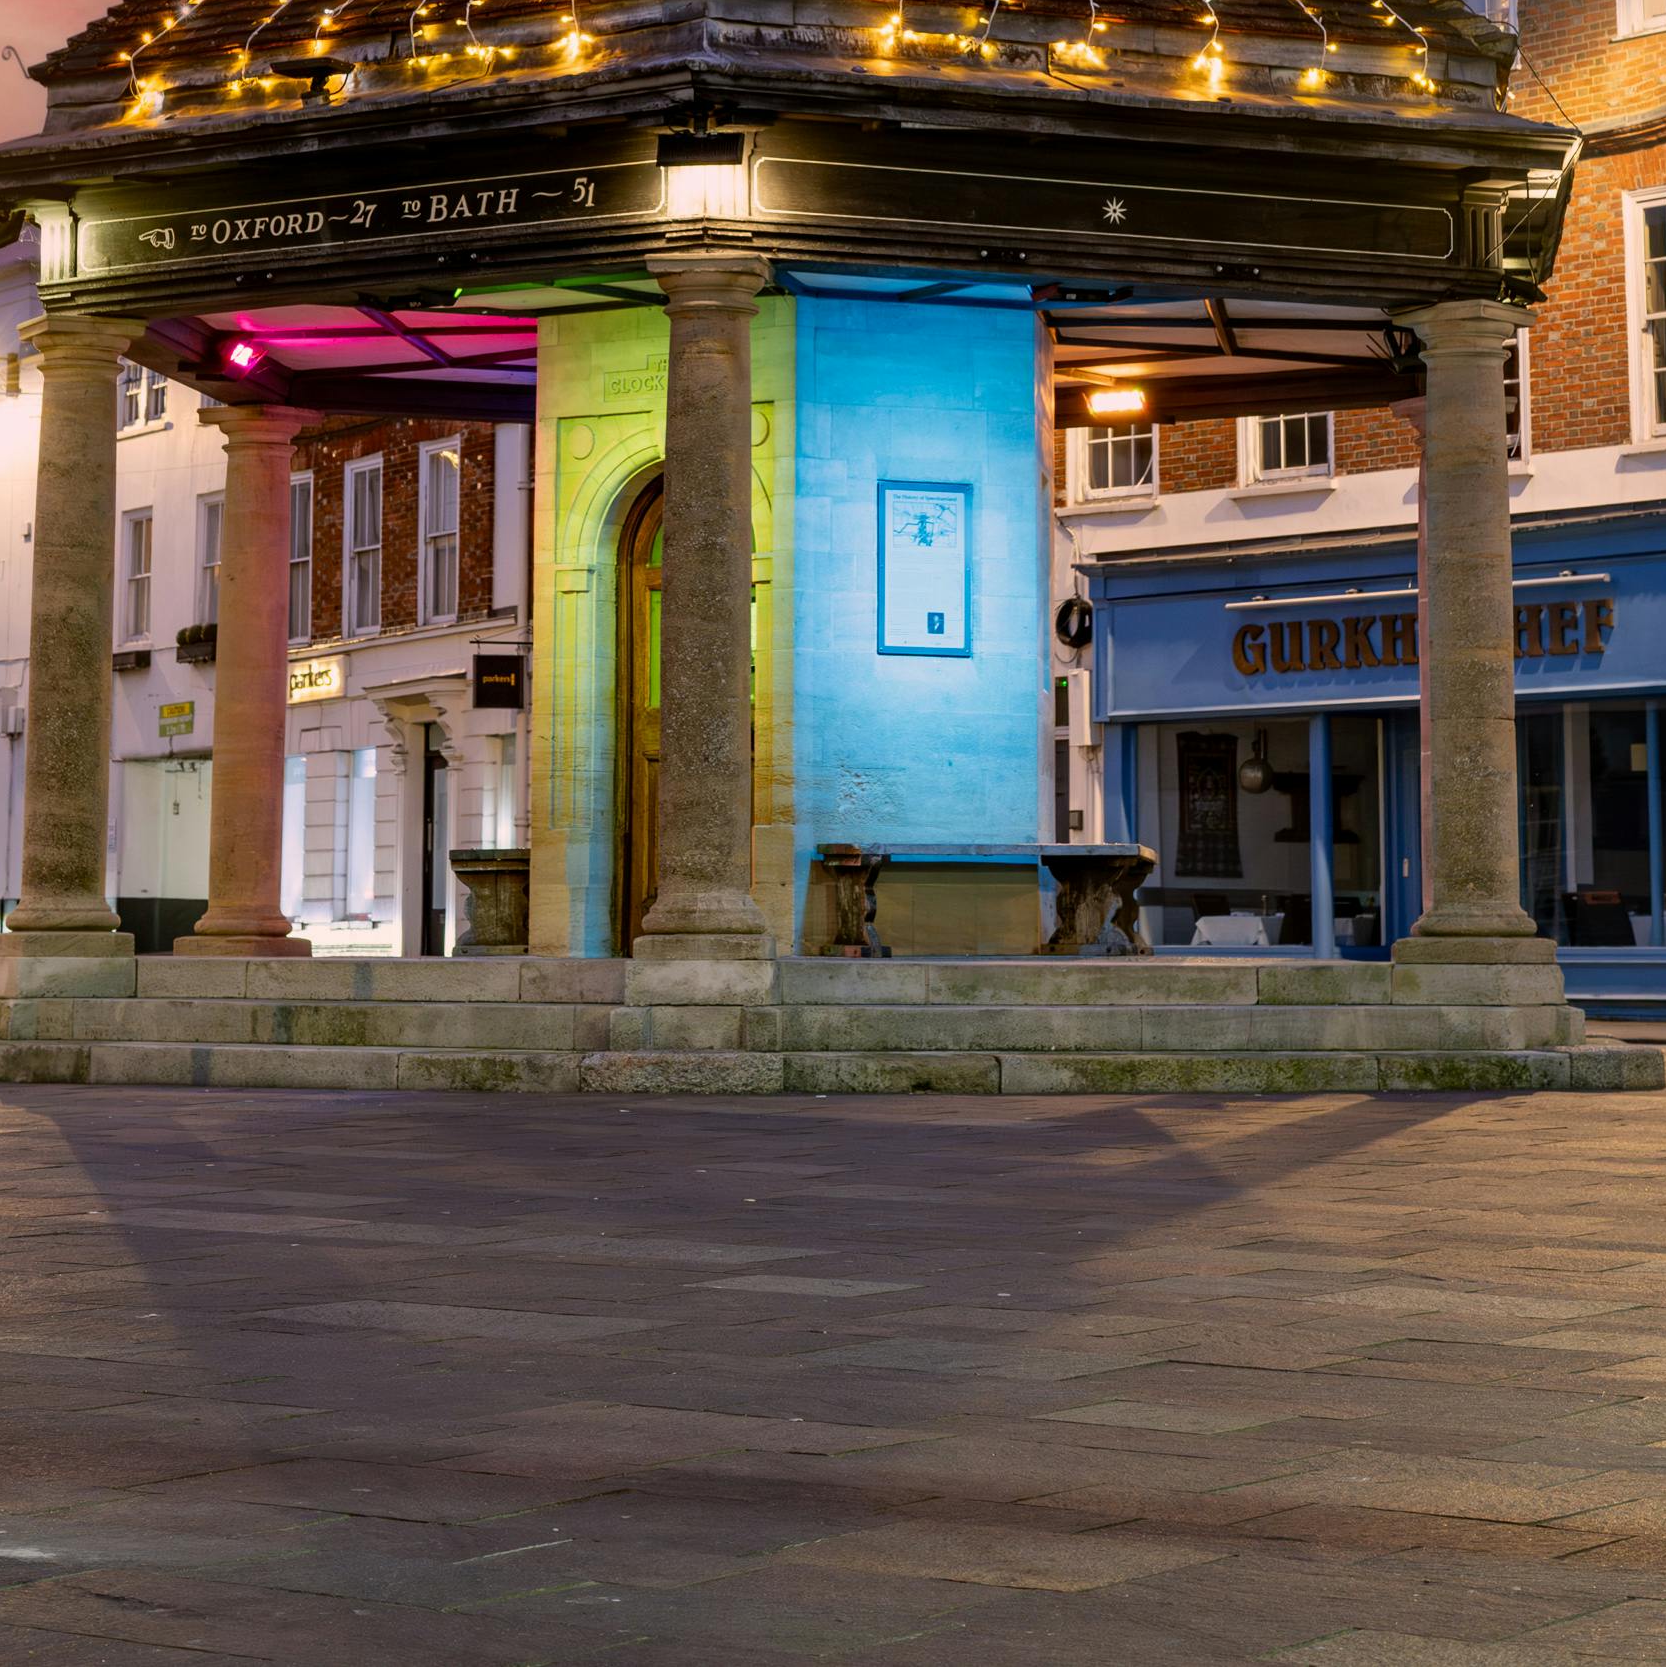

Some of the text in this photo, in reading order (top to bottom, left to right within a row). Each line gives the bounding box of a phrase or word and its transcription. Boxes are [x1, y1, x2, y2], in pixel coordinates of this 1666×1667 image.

[190, 177, 595, 245] TO OXFORD 27 TO BATH 51
[611, 375, 665, 395] CLOCK
[1234, 597, 1614, 676] GURKH HEF
